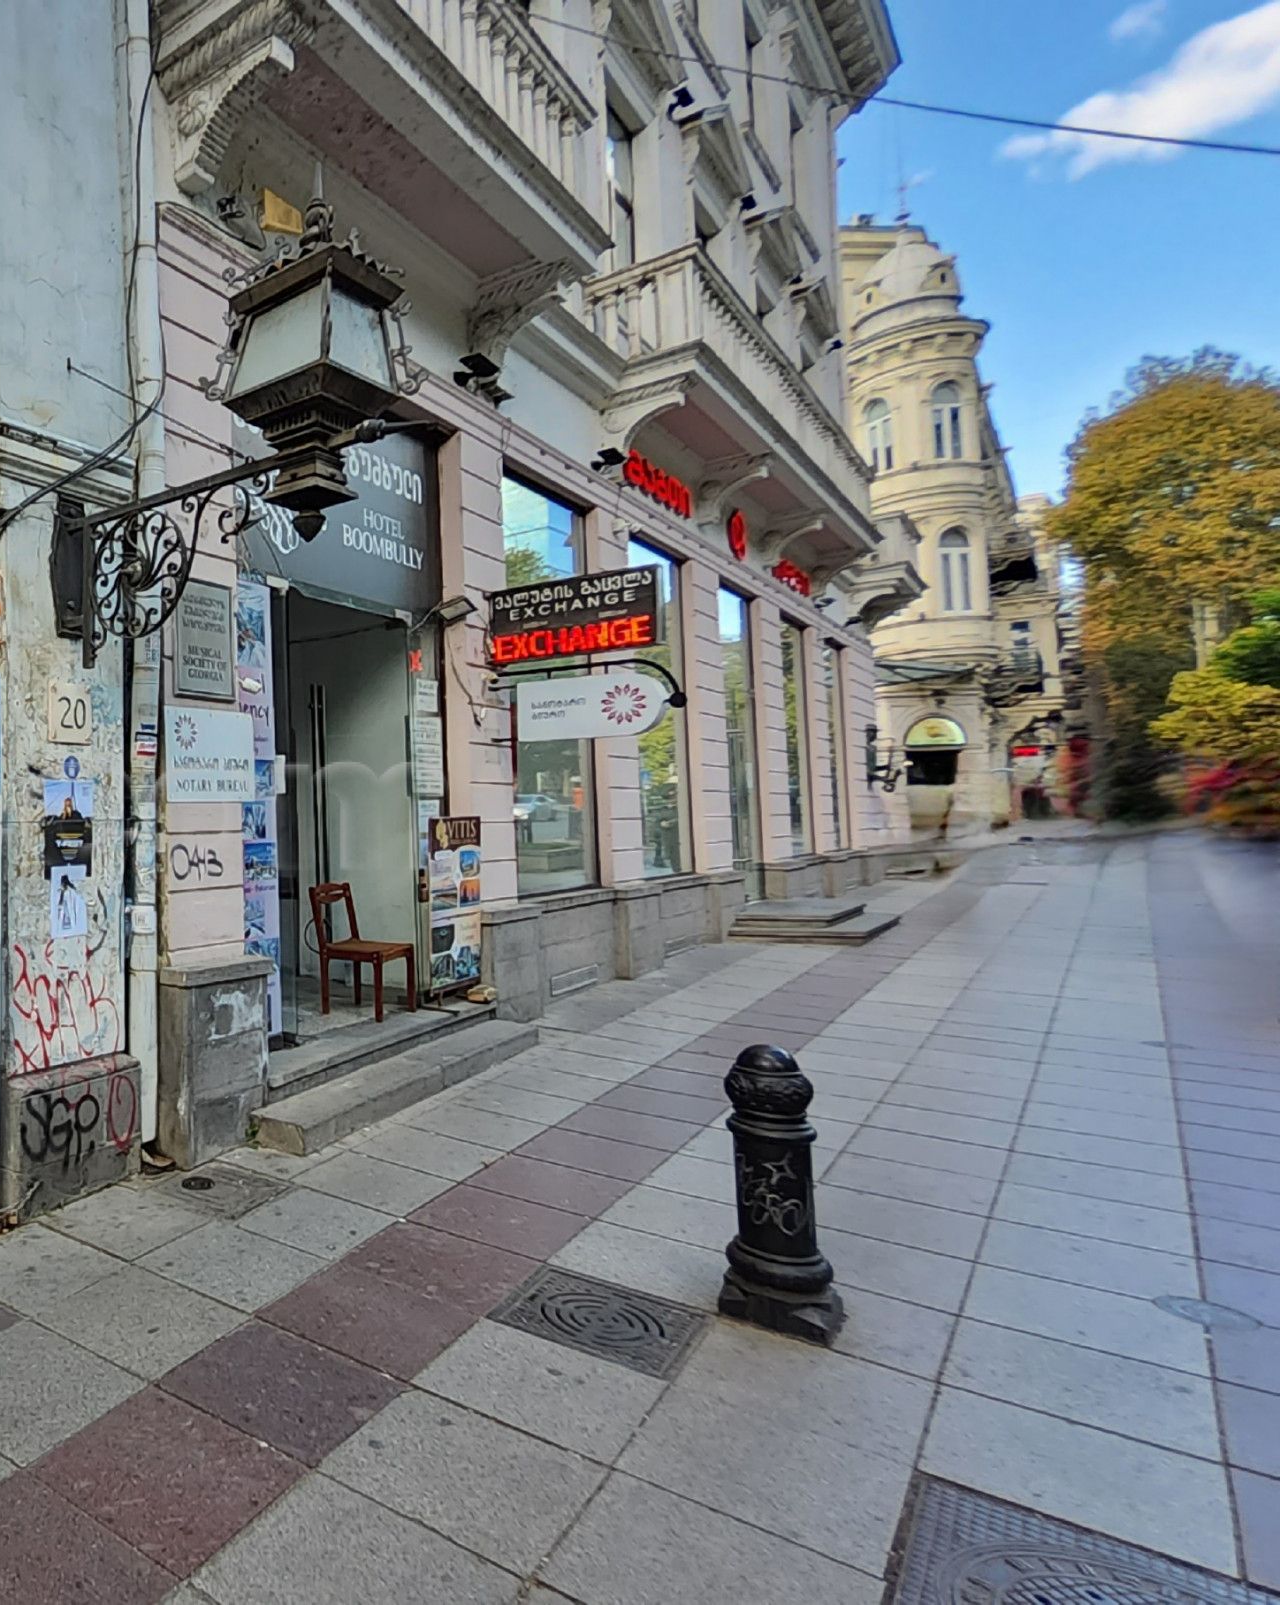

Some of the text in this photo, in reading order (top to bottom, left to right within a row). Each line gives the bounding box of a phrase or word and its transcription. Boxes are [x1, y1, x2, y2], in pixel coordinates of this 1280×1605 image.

[363, 507, 405, 540] HOTEL
[343, 523, 424, 571] BOOMBULLY
[495, 571, 653, 611] ვალუტის გაცვლა
[509, 589, 636, 621] EXCHANGE
[494, 614, 652, 663] EXCHANGE
[183, 655, 216, 670] SOCIETY
[58, 696, 86, 730] 20
[176, 778, 249, 793] NOTARY BUREAU
[446, 819, 477, 839] VITIS
